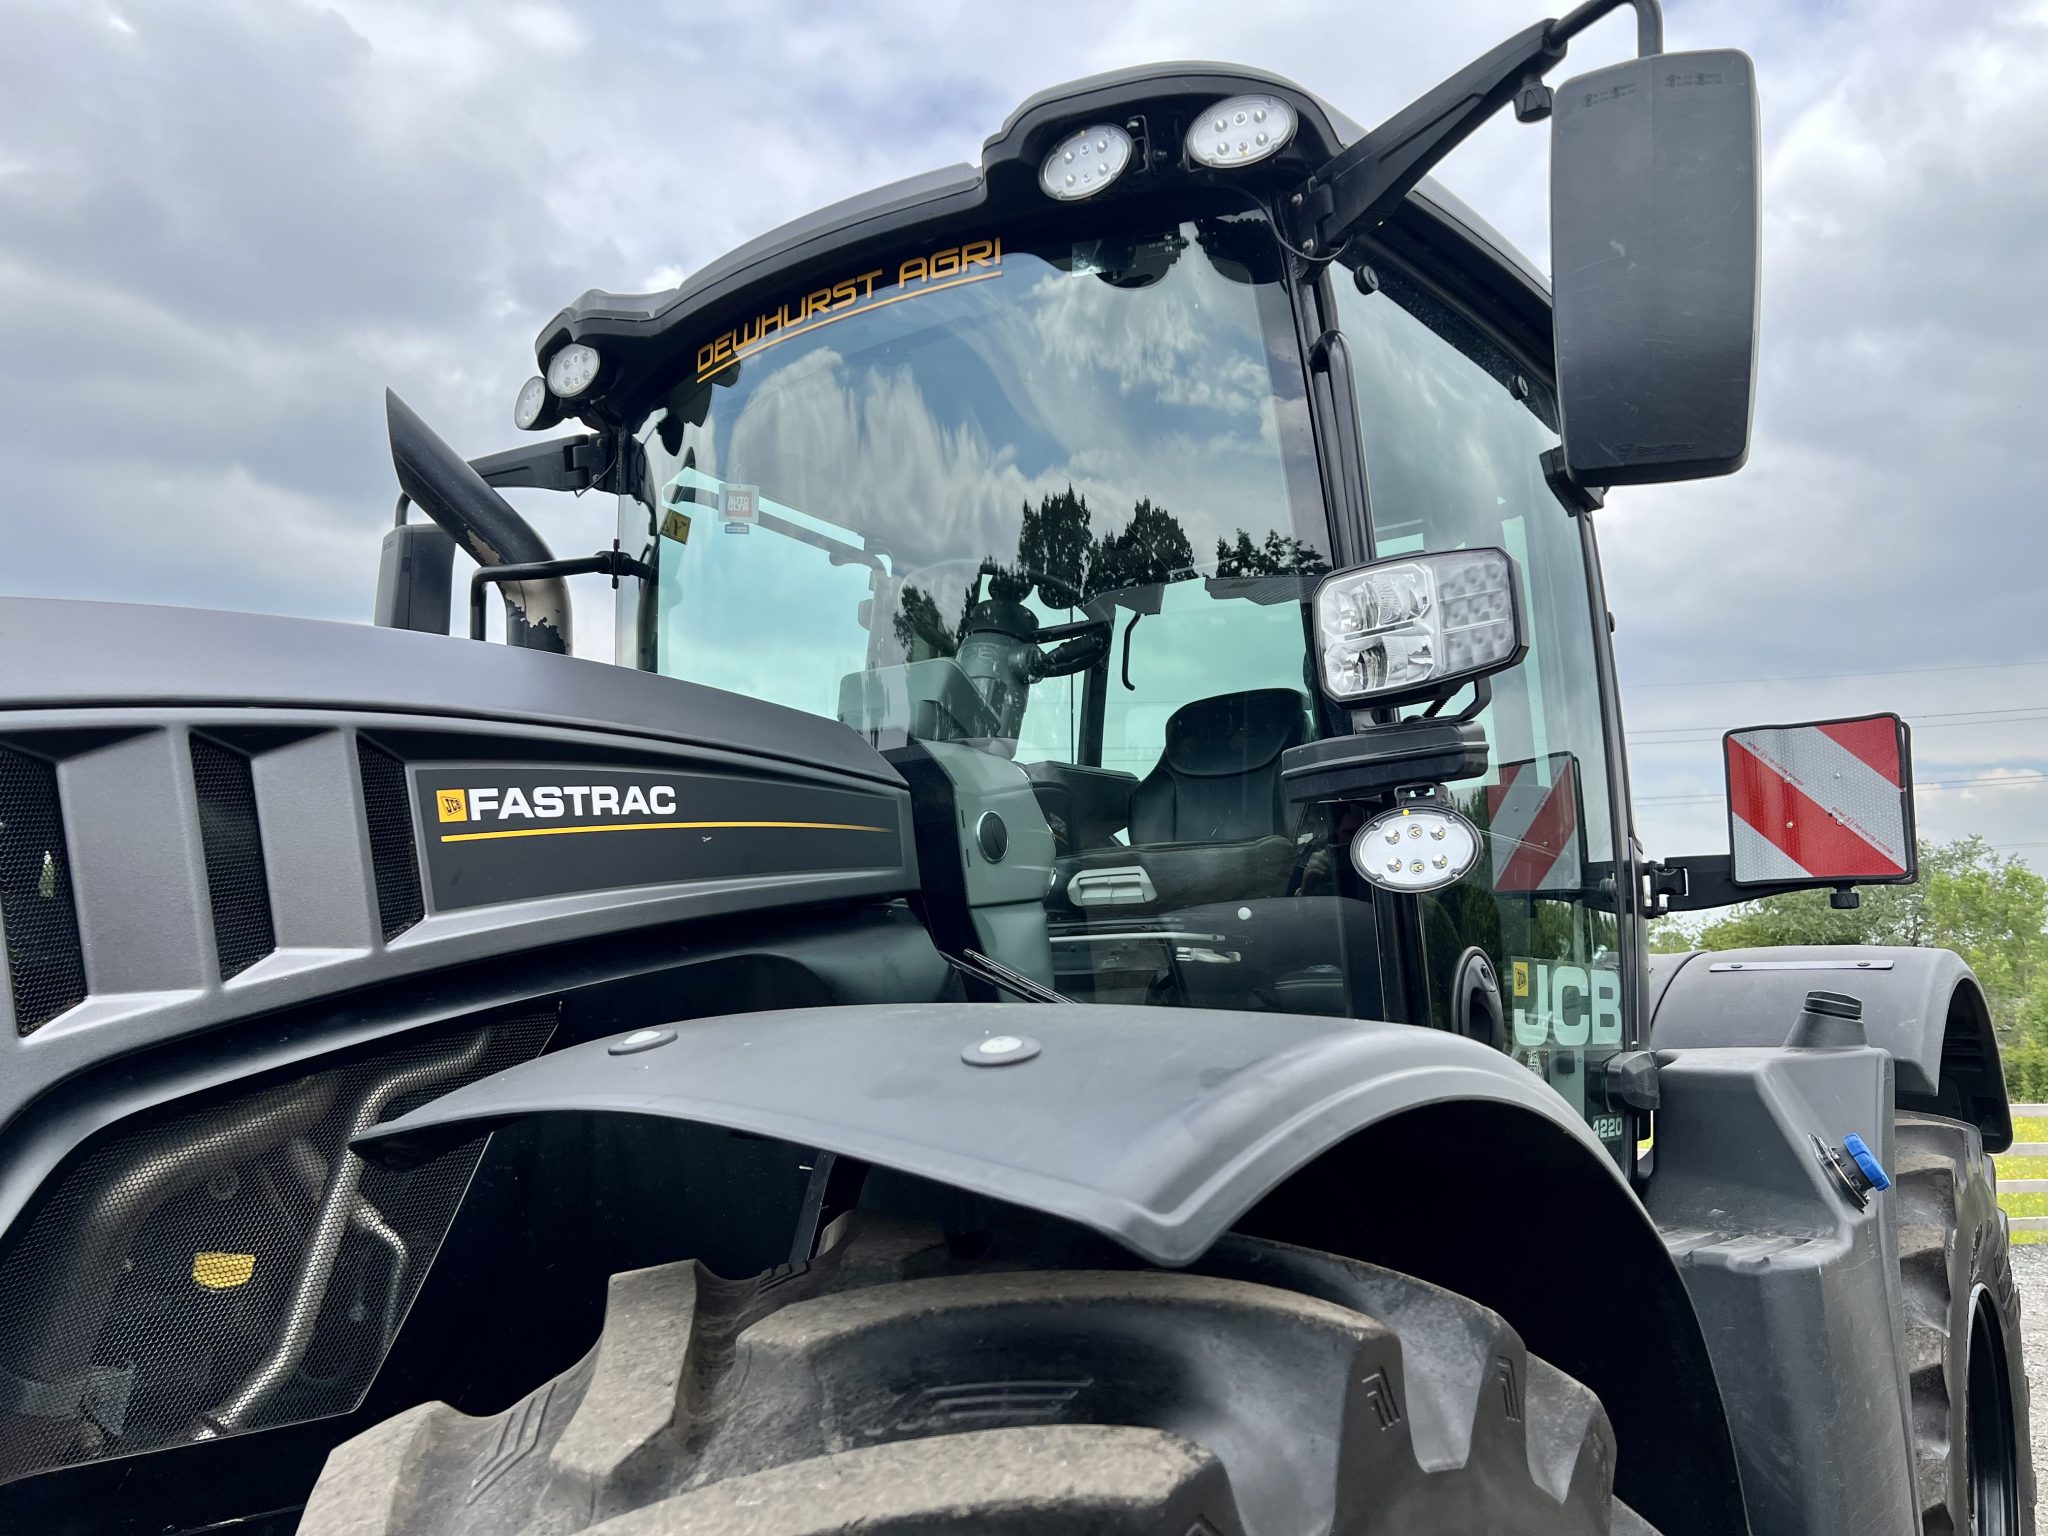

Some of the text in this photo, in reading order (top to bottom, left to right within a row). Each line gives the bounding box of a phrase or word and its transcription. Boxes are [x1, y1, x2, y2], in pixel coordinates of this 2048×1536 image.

[697, 237, 1002, 374] DEWHURST AGRI
[468, 786, 677, 821] FASTRAC
[1514, 964, 1623, 1046] JCB
[1593, 1117, 1622, 1138] 4220
